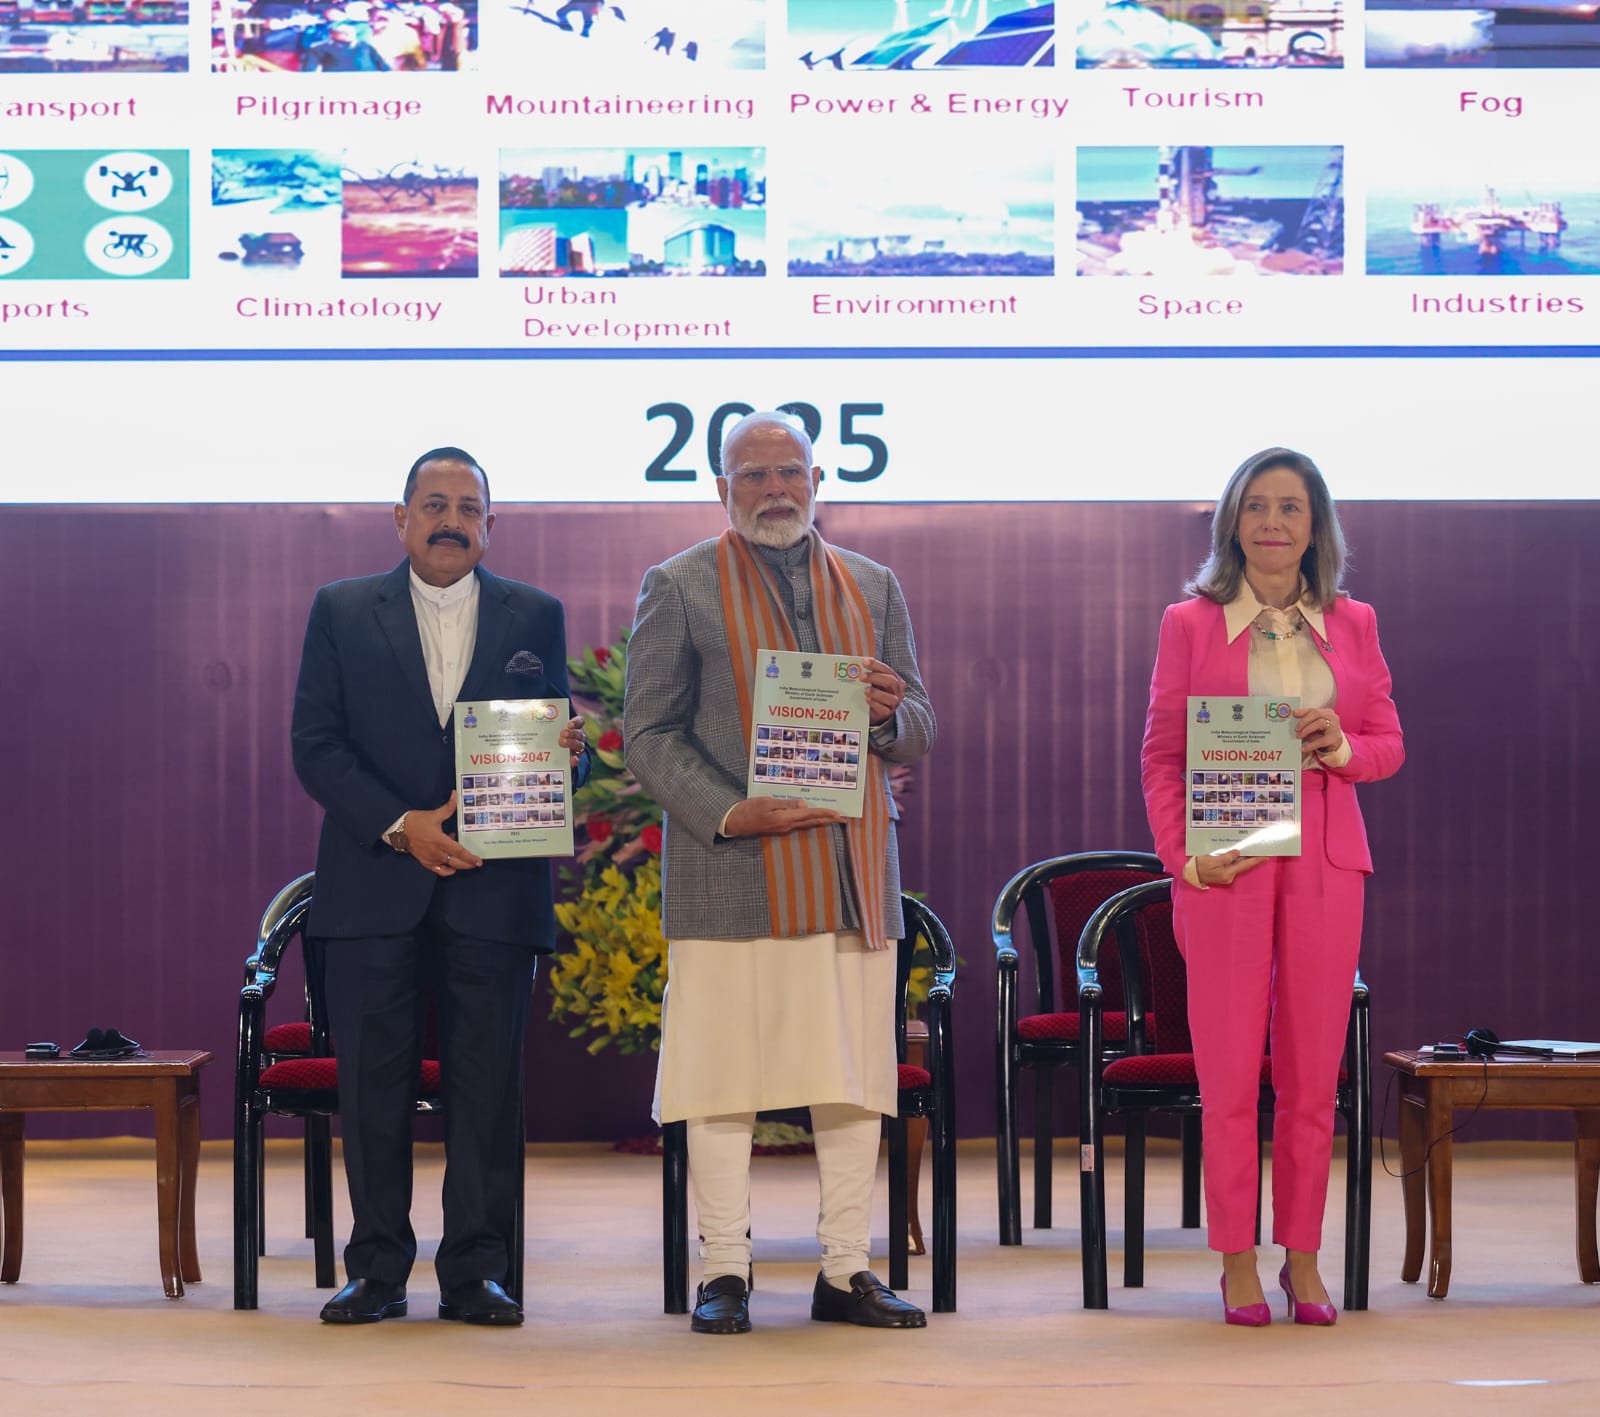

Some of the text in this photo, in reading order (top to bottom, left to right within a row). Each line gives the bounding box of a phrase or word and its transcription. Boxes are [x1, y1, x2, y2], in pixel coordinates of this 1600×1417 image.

[1, 97, 137, 122] ansport
[235, 95, 423, 120] Pilgrimage
[486, 94, 755, 119] Mountaineering
[790, 93, 1070, 118] Power & Energy
[1121, 87, 1265, 109] Tourism
[1459, 91, 1524, 118] Fog
[523, 285, 618, 306] Urban
[812, 293, 1018, 315] Environment
[1137, 294, 1244, 320] Space
[1411, 292, 1585, 314] Industries
[1, 298, 91, 323] ports
[235, 296, 443, 321] Climatology
[523, 318, 732, 343] Development
[768, 705, 850, 721] VISION-2047
[470, 751, 551, 766] VISION-2047
[1201, 750, 1283, 761] VISION-2047
